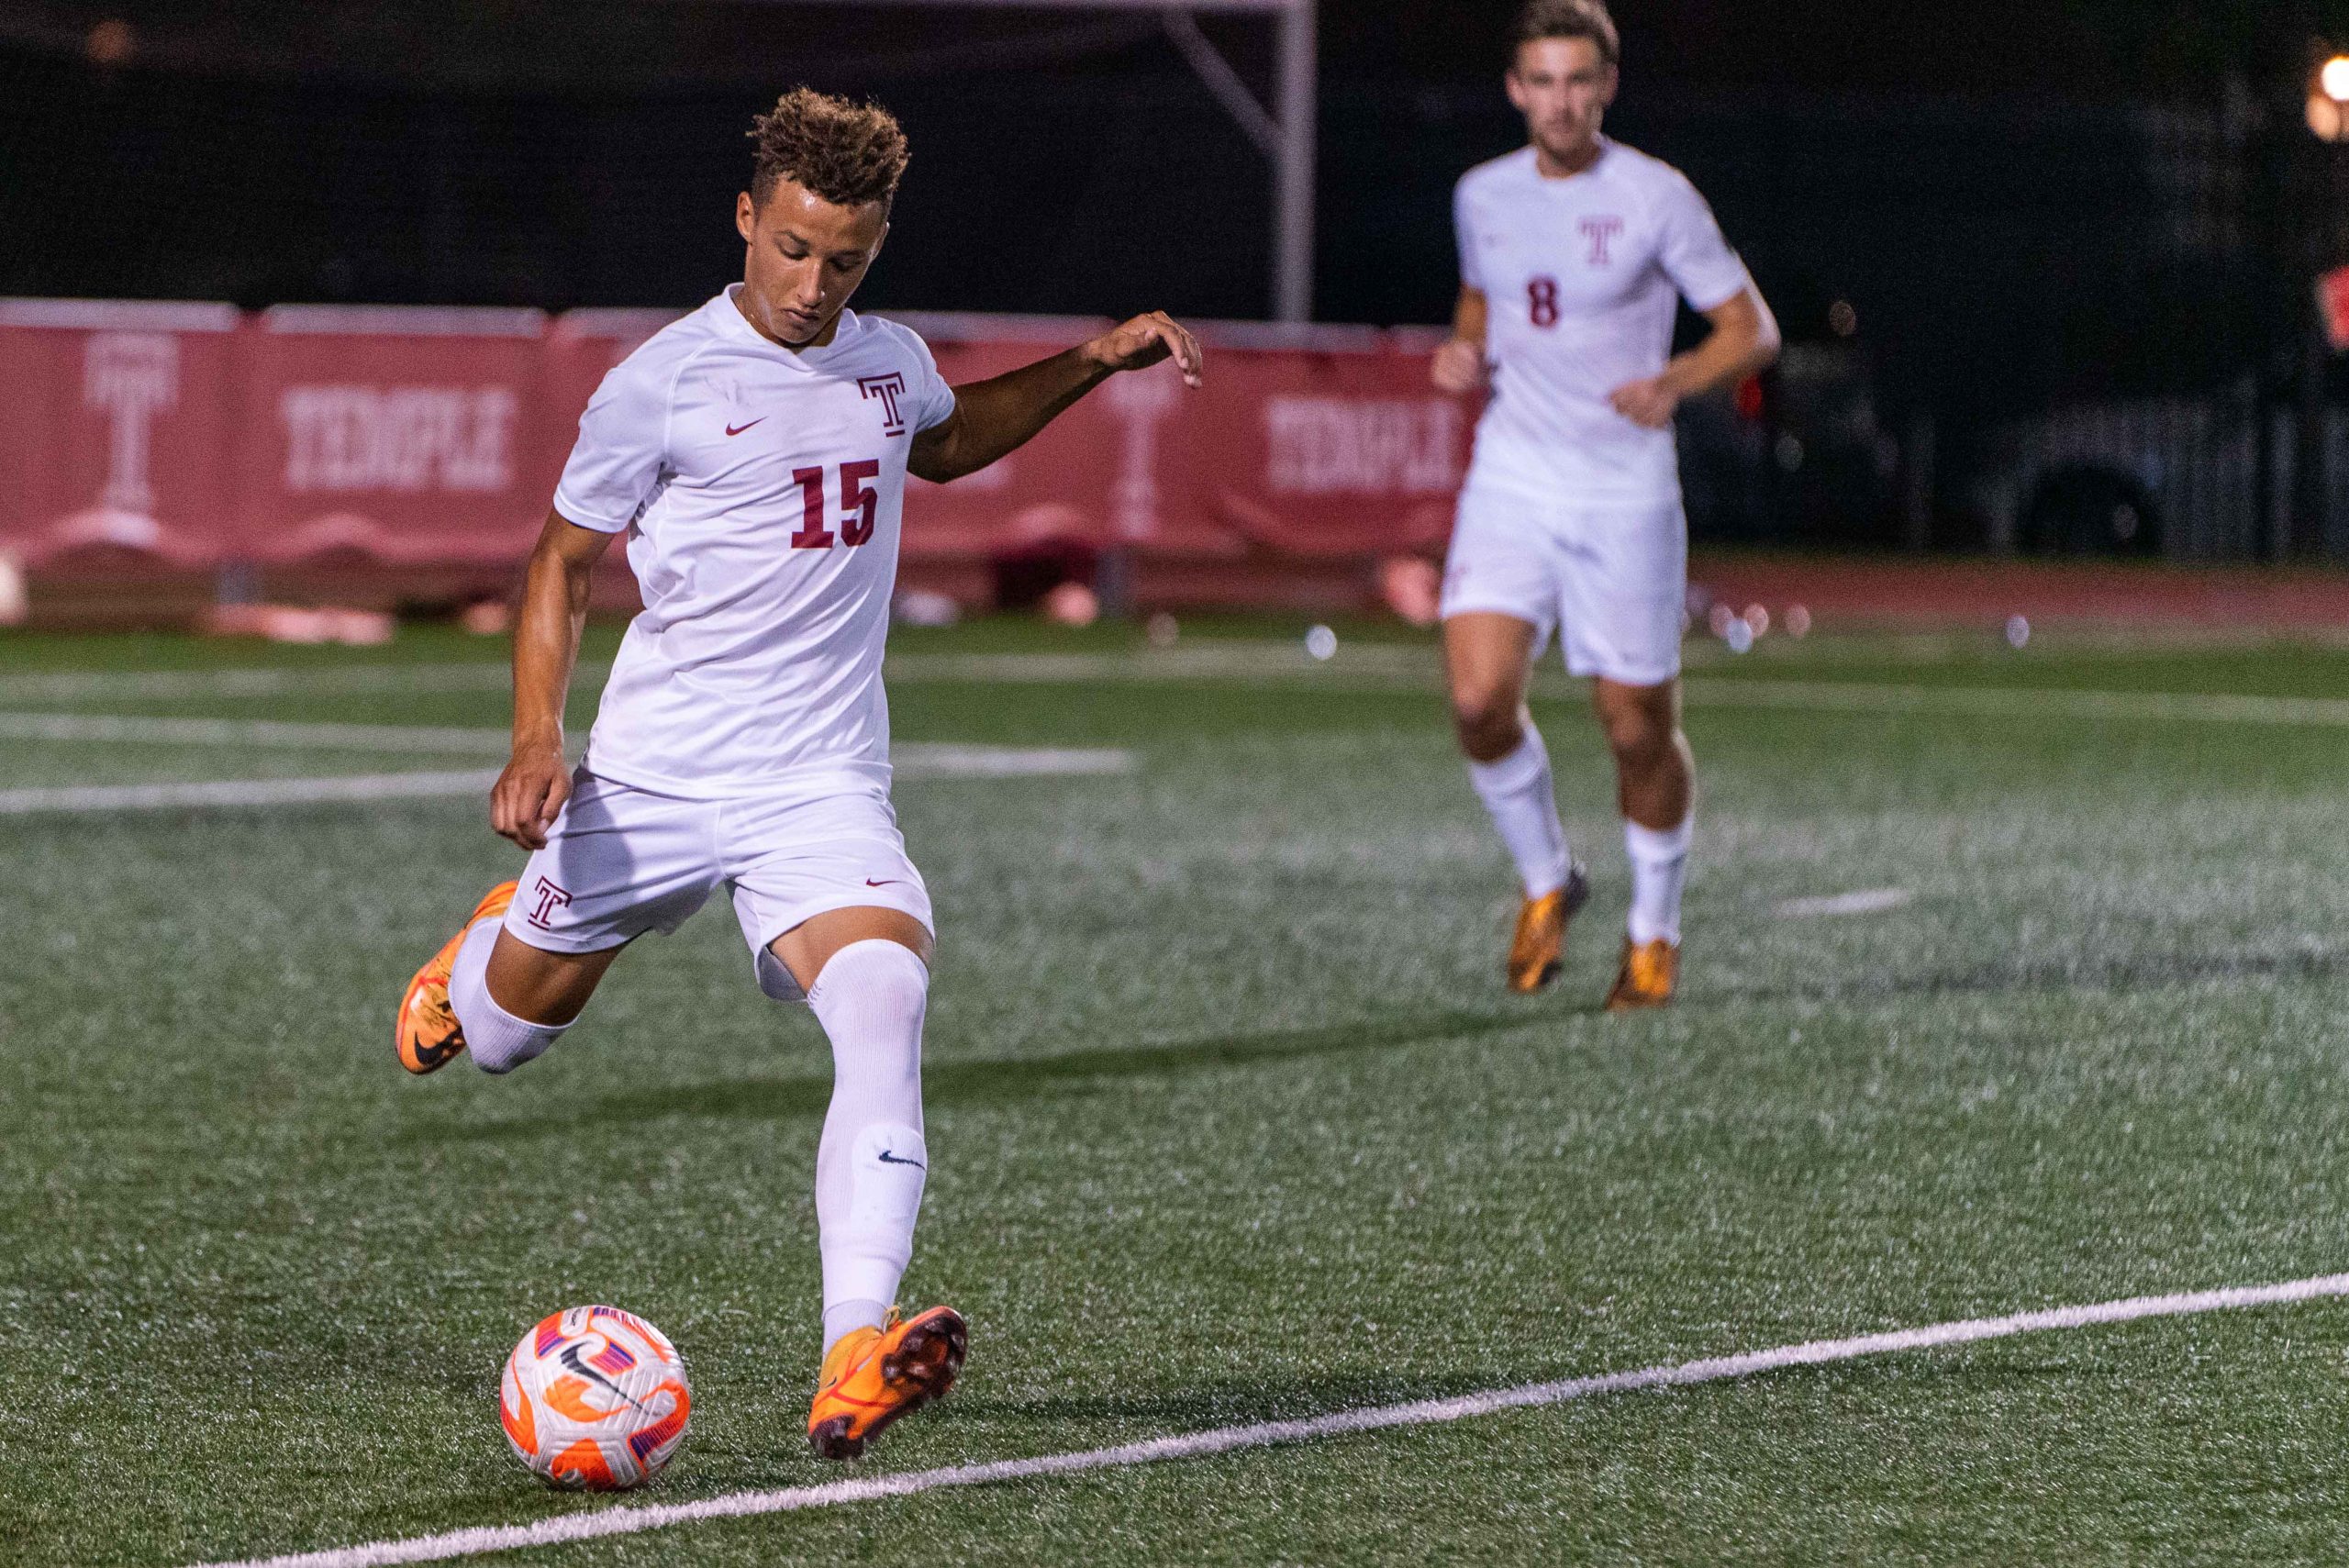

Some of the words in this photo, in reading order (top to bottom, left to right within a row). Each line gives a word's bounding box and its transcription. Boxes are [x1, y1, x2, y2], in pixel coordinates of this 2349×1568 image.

[1527, 276, 1558, 328] 8
[856, 371, 906, 438] T
[791, 459, 879, 550] 15
[528, 874, 573, 932] T
